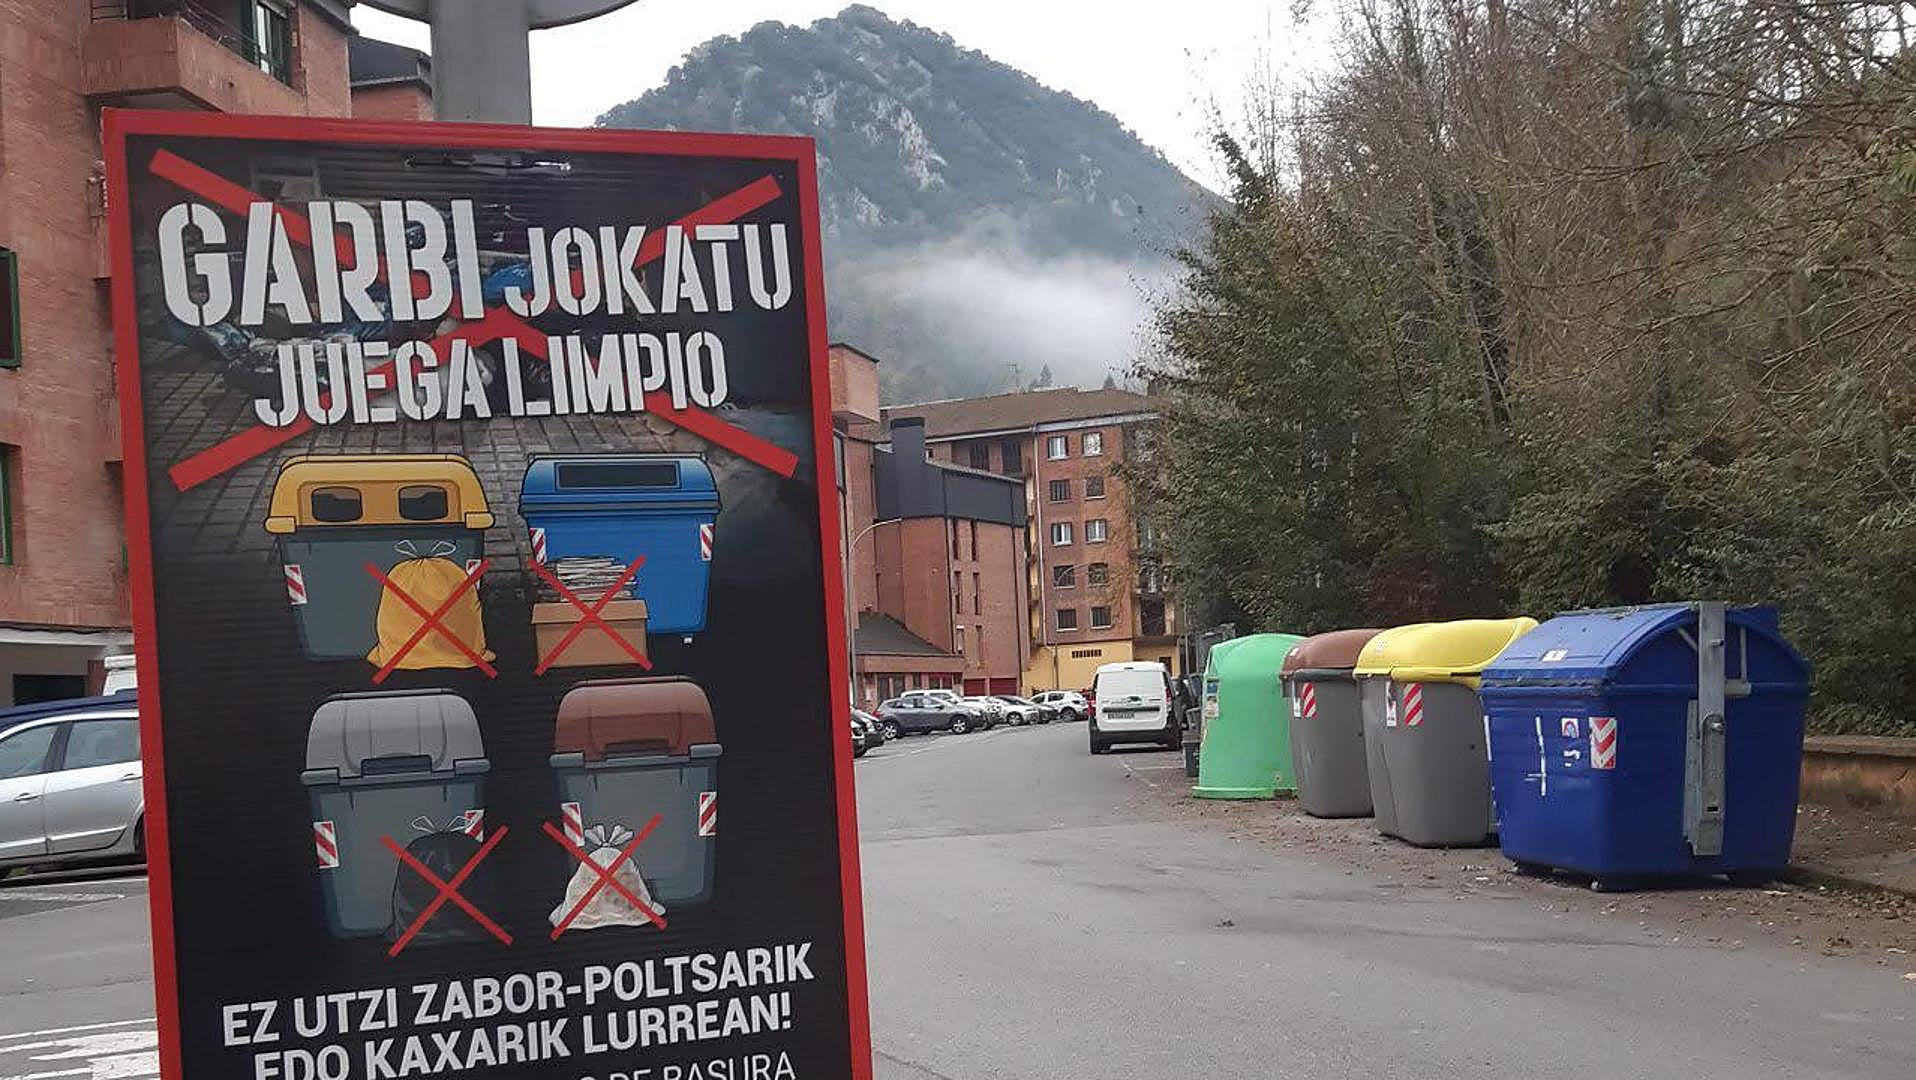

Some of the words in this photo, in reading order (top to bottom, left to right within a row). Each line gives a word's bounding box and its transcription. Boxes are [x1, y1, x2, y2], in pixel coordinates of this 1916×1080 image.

[158, 199, 484, 327] GARBI
[504, 223, 792, 317] JOKATU
[254, 338, 492, 427] JUEGA
[502, 331, 728, 416] LIMPIO
[222, 1000, 280, 1047] EZ
[294, 987, 398, 1038] UTZI
[412, 942, 815, 1026] ZABOR-POLTSARIK
[254, 1044, 350, 1080] EDO
[364, 1017, 572, 1080] KAXARIK
[583, 991, 792, 1055] LURREAN!
